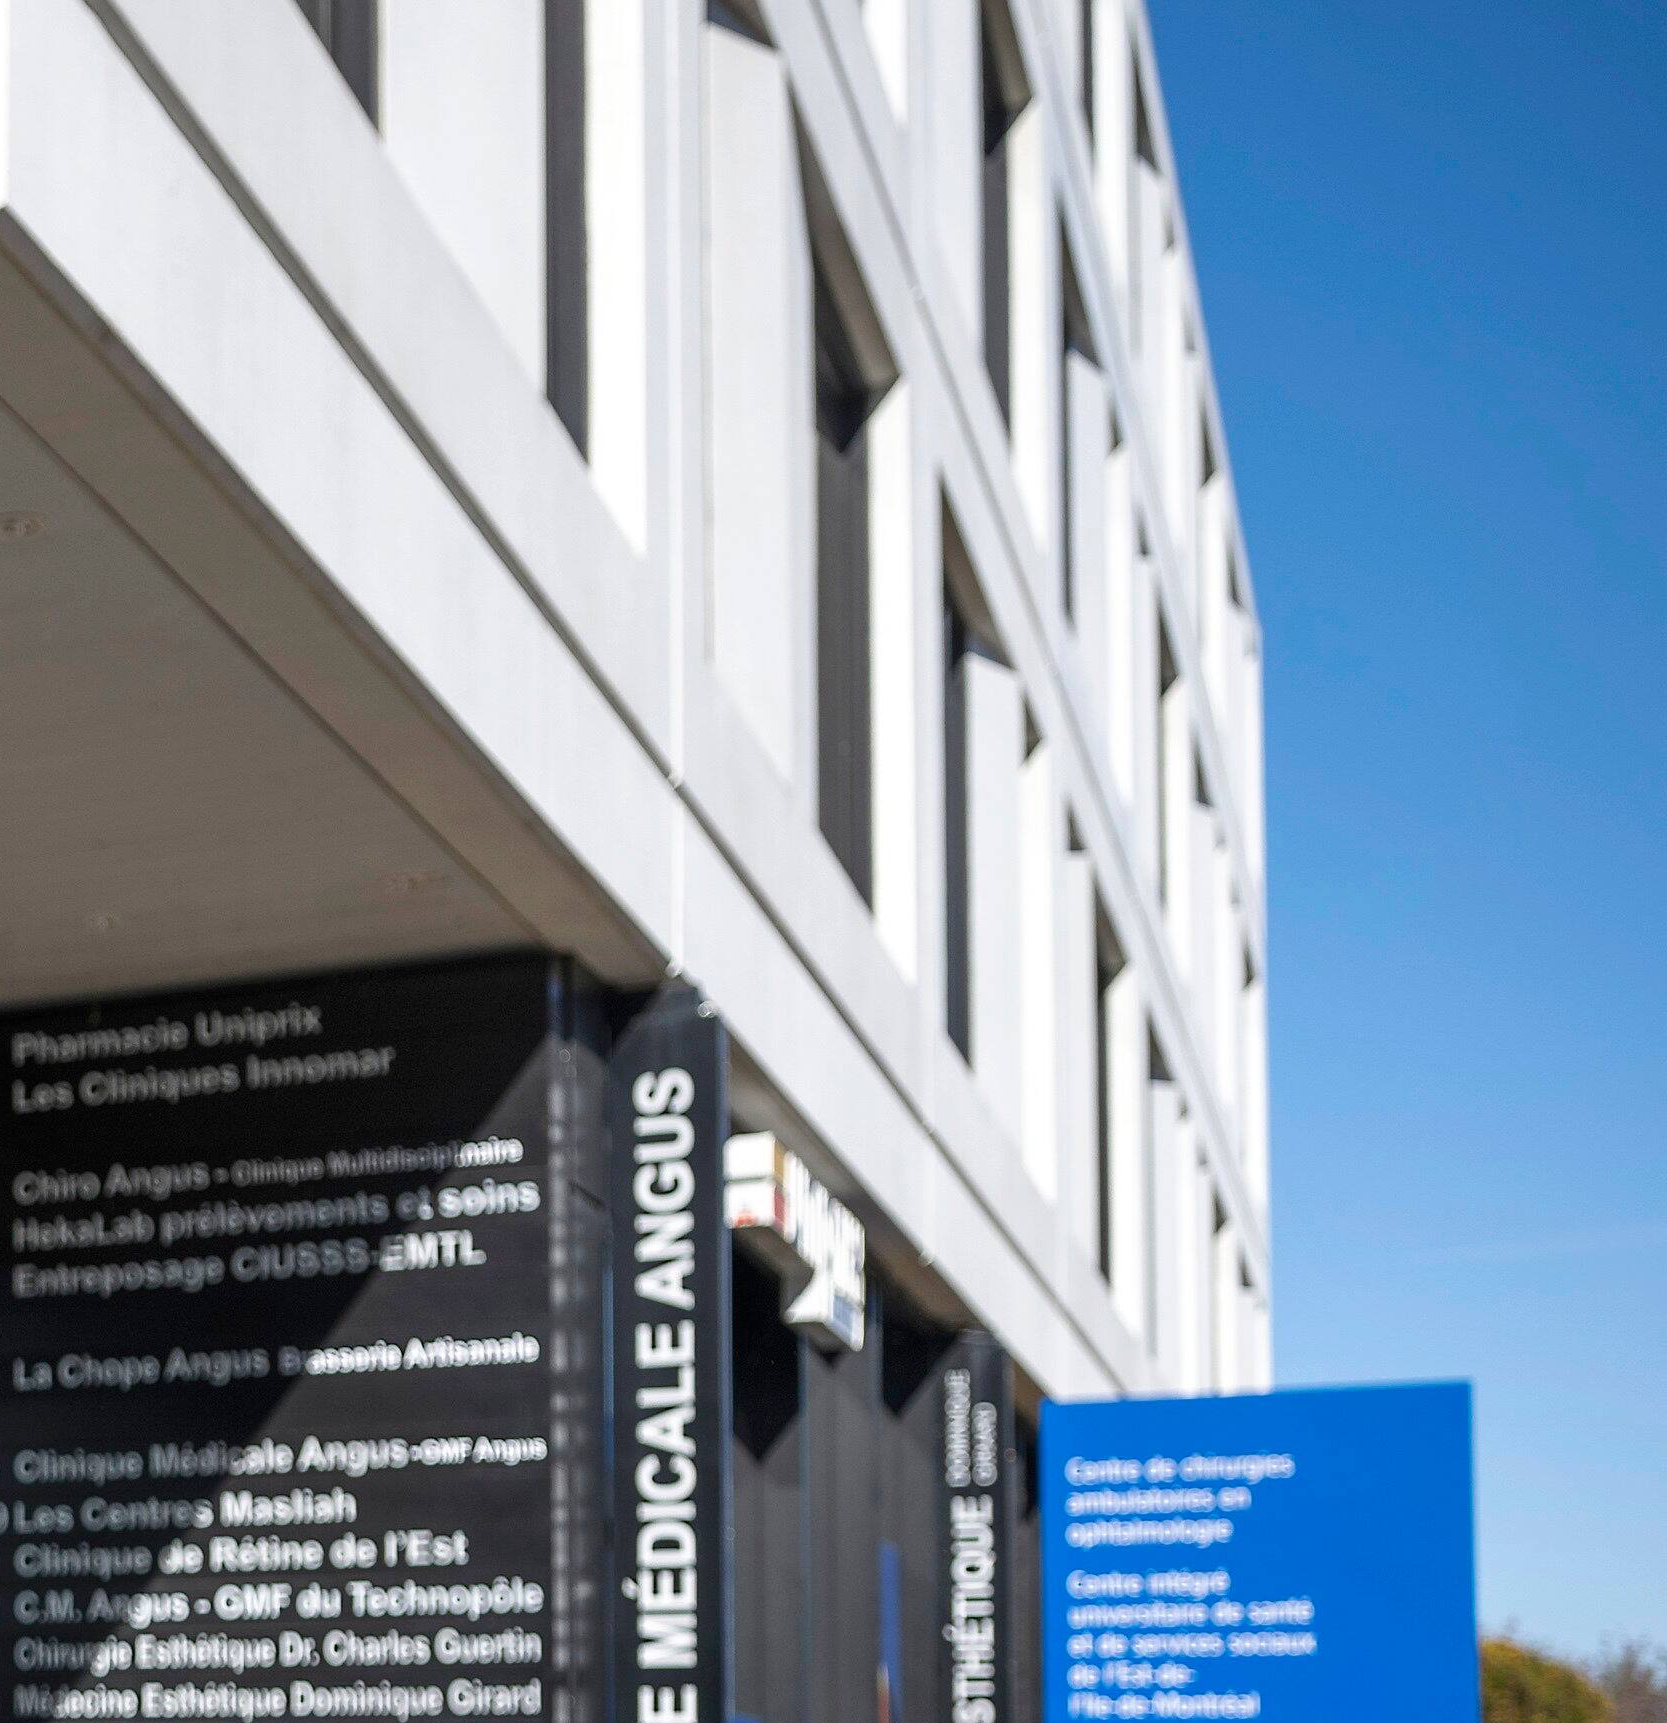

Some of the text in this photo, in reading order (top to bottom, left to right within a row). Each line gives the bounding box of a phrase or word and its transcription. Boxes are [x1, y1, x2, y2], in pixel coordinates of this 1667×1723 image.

[11, 1017, 190, 1068] Pharmacie
[192, 1003, 324, 1050] Uniprix
[11, 1077, 74, 1115] Les
[78, 1060, 241, 1107] Cliniques
[244, 1046, 395, 1089] Innomar
[12, 1168, 101, 1205] Chiro
[103, 1162, 211, 1201] Angus
[231, 1155, 325, 1187] Clinique
[437, 1178, 541, 1219] soins
[633, 1069, 695, 1310] ANGUS
[11, 1253, 224, 1300] Entreposage
[12, 1357, 53, 1394] La
[58, 1351, 160, 1395] Chope
[164, 1345, 269, 1387] Angus
[402, 1331, 540, 1371] Artisanale
[13, 1445, 142, 1484] Clinique
[148, 1439, 294, 1479] Médicale
[296, 1435, 407, 1477] Angus
[472, 1435, 548, 1467] Angus
[14, 1498, 74, 1534] Les
[81, 1492, 213, 1531] Centres
[623, 1320, 698, 1670] MÉDICALE
[13, 1540, 152, 1580] Clinique
[159, 1535, 204, 1574] de
[209, 1531, 324, 1573] Rétine
[329, 1529, 378, 1569] de
[13, 1591, 83, 1625] C.M.
[87, 1590, 190, 1629] Angus
[212, 1584, 294, 1621] GMF
[295, 1581, 342, 1619] du
[349, 1575, 545, 1621] Technopôle
[13, 1636, 132, 1677] Chirurgie
[134, 1631, 276, 1674] Esthétique
[278, 1631, 321, 1666] Dr.
[322, 1628, 432, 1666] Charles
[434, 1626, 542, 1666] Guertin
[13, 1684, 139, 1719] Médecine
[141, 1681, 287, 1723] Esthétique
[289, 1680, 444, 1722] Dominique
[446, 1677, 542, 1716] Girard
